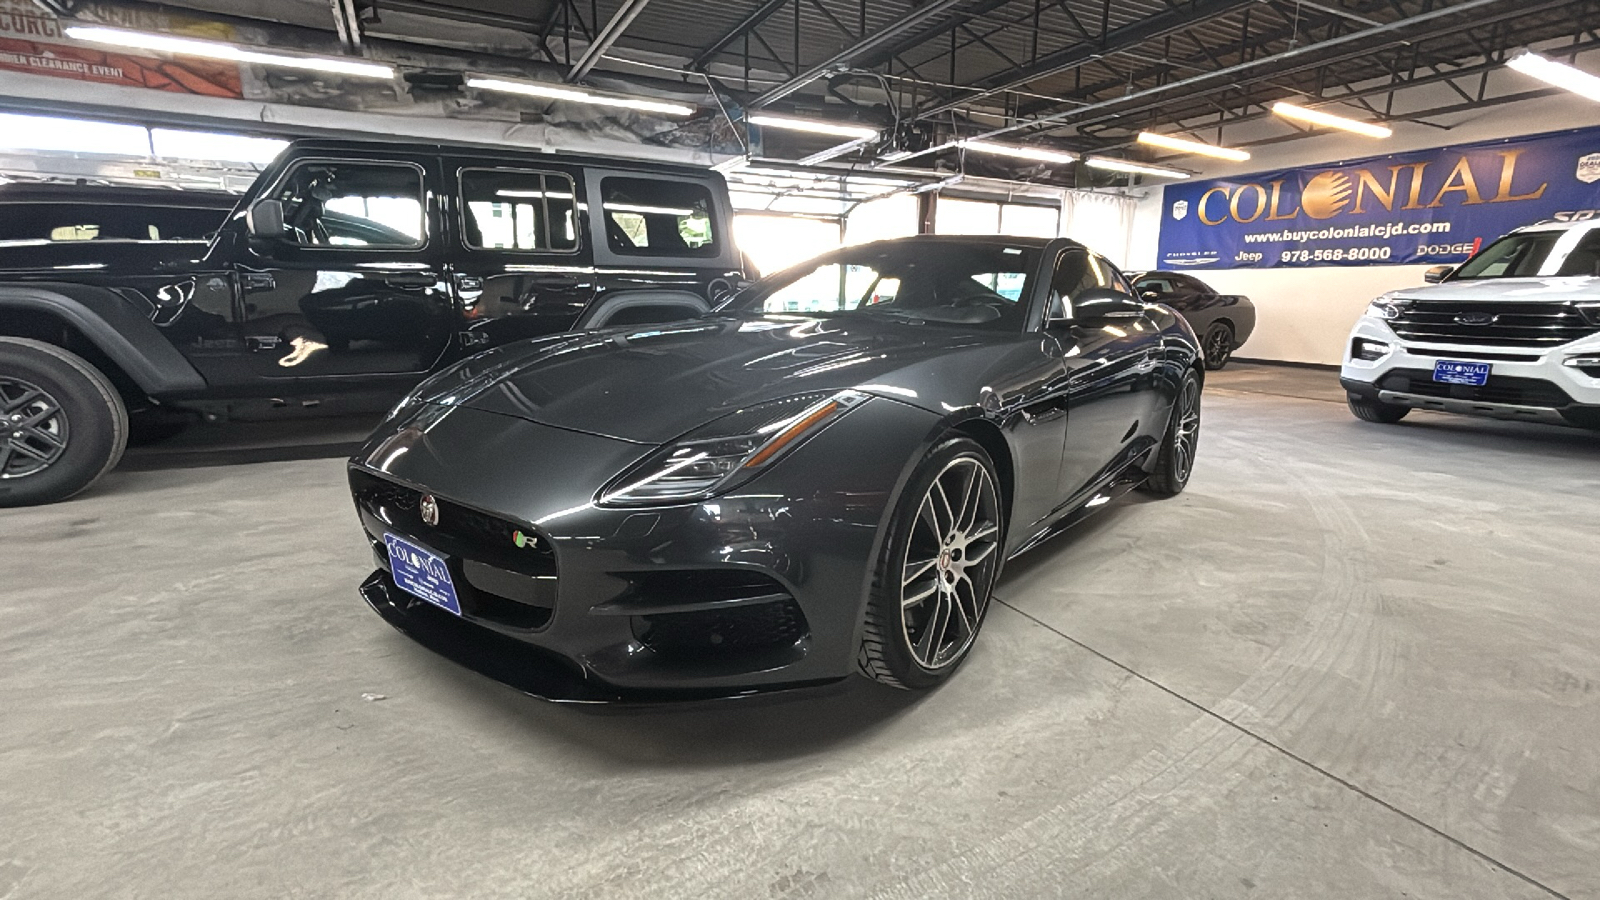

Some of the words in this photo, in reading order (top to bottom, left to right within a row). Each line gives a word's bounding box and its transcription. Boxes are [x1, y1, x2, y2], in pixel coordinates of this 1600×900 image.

[29, 57, 90, 73] CLEARANCE
[92, 65, 123, 77] EVENT
[1197, 150, 1548, 226] COLONIAL
[1244, 222, 1451, 244] www.buycolonialcjd.com
[1234, 251, 1263, 262] Jeep
[1281, 247, 1391, 262] 978-568-8000
[1417, 243, 1475, 256] DODGE
[1436, 363, 1487, 373] COLONIAL
[387, 542, 451, 584] COLONIAL
